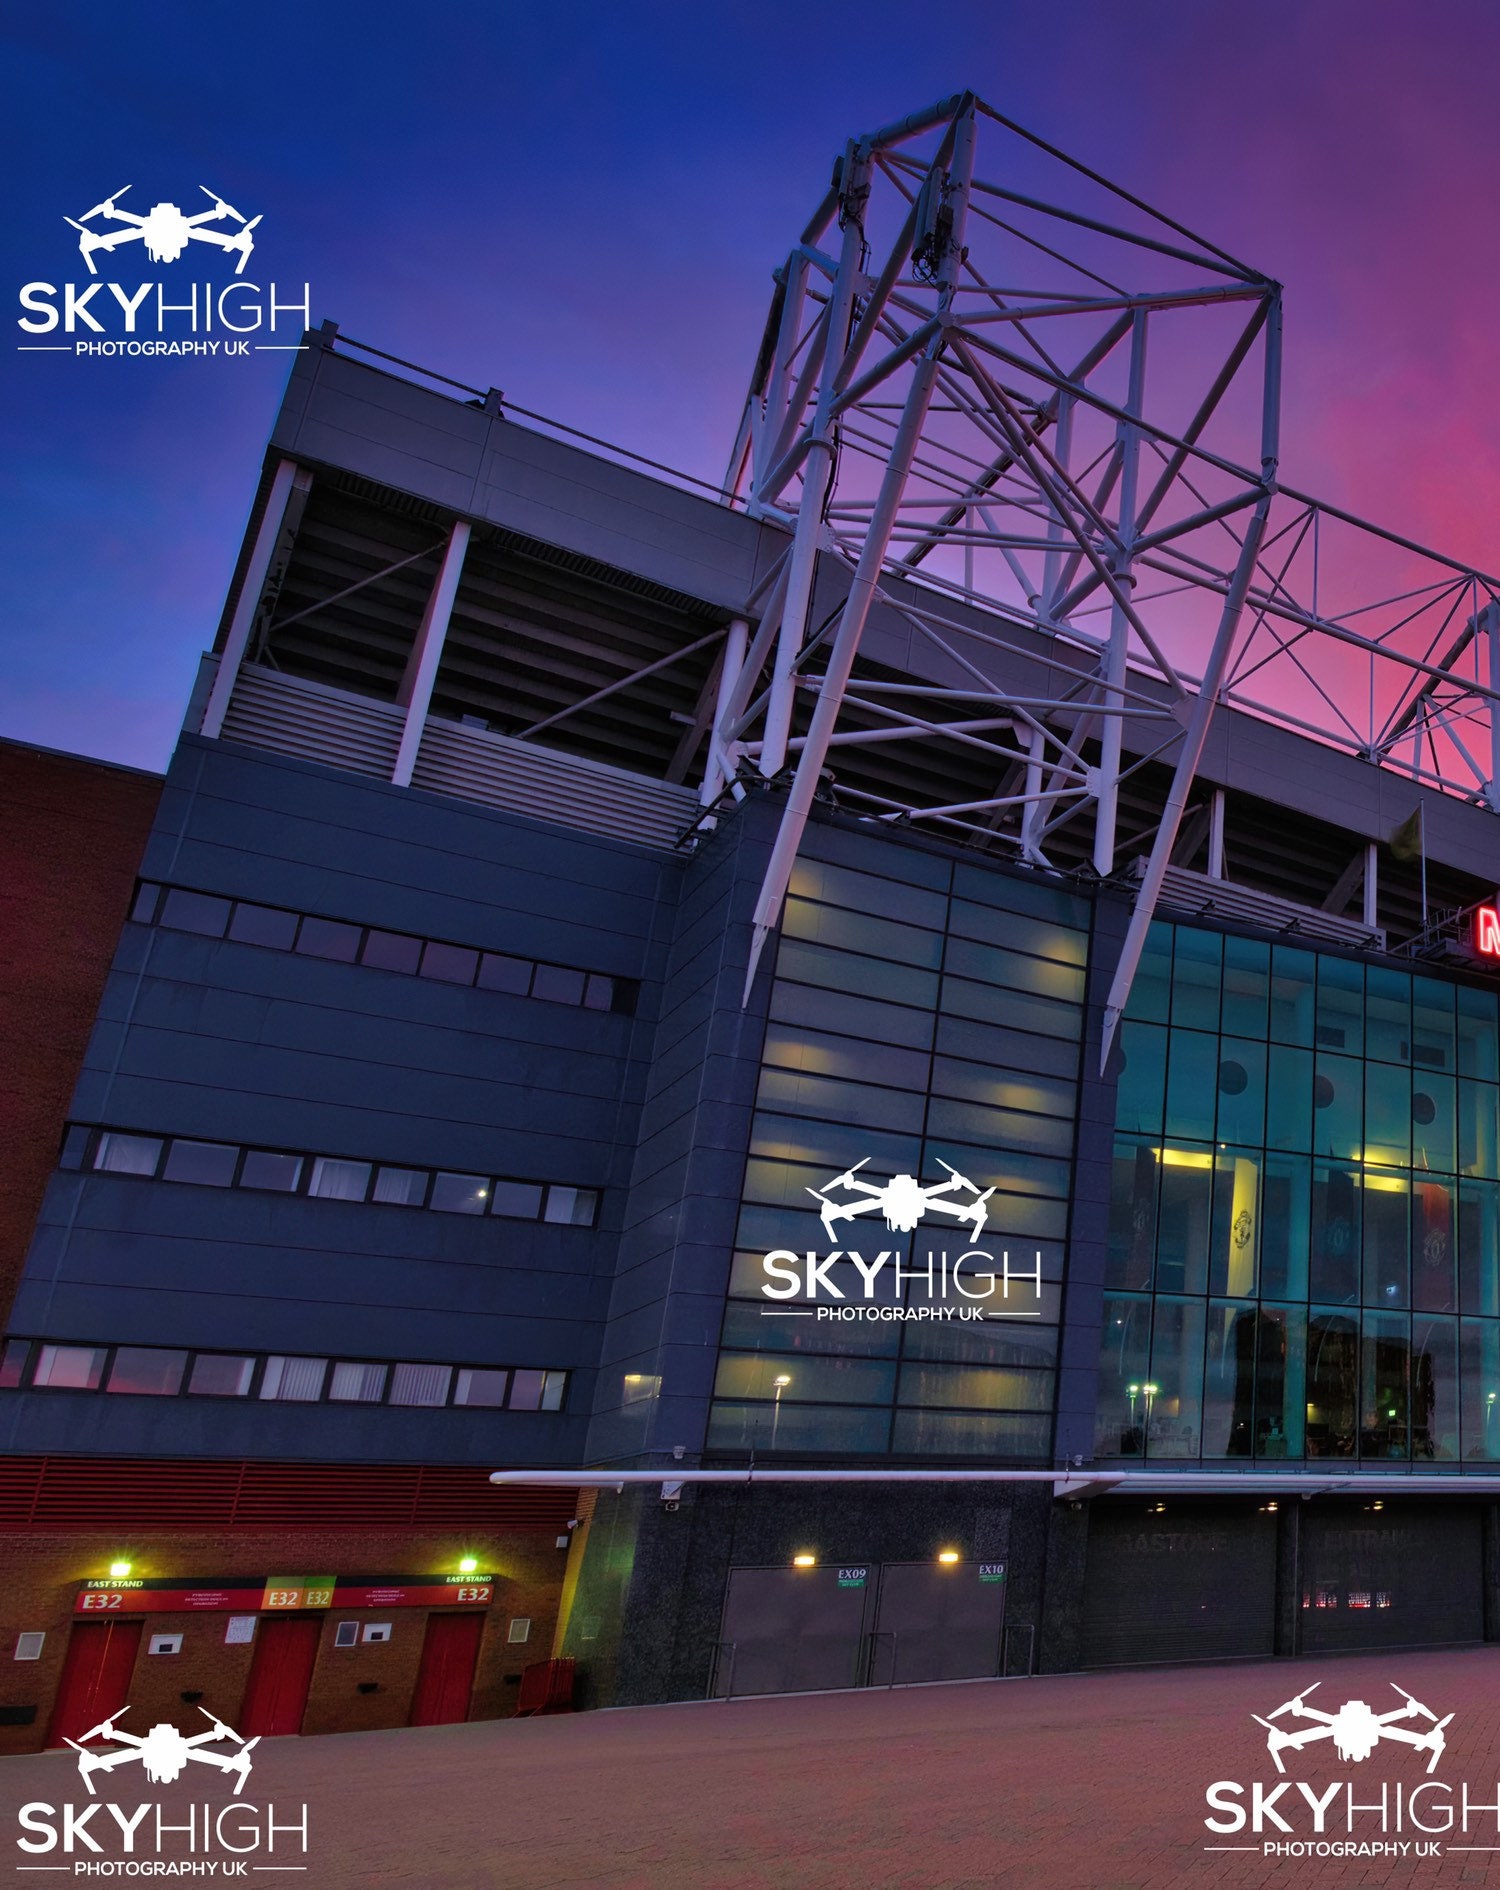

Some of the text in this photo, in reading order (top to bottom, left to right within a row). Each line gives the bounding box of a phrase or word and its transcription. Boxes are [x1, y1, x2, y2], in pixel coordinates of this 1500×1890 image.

[838, 1568, 867, 1580] EX09
[979, 1564, 1004, 1575] EX10
[87, 1579, 144, 1588] EAST STAND
[466, 1575, 492, 1583] STAND
[268, 1591, 299, 1606] E32
[306, 1591, 330, 1606] E32
[457, 1587, 490, 1602] E32
[82, 1593, 123, 1610] E32
